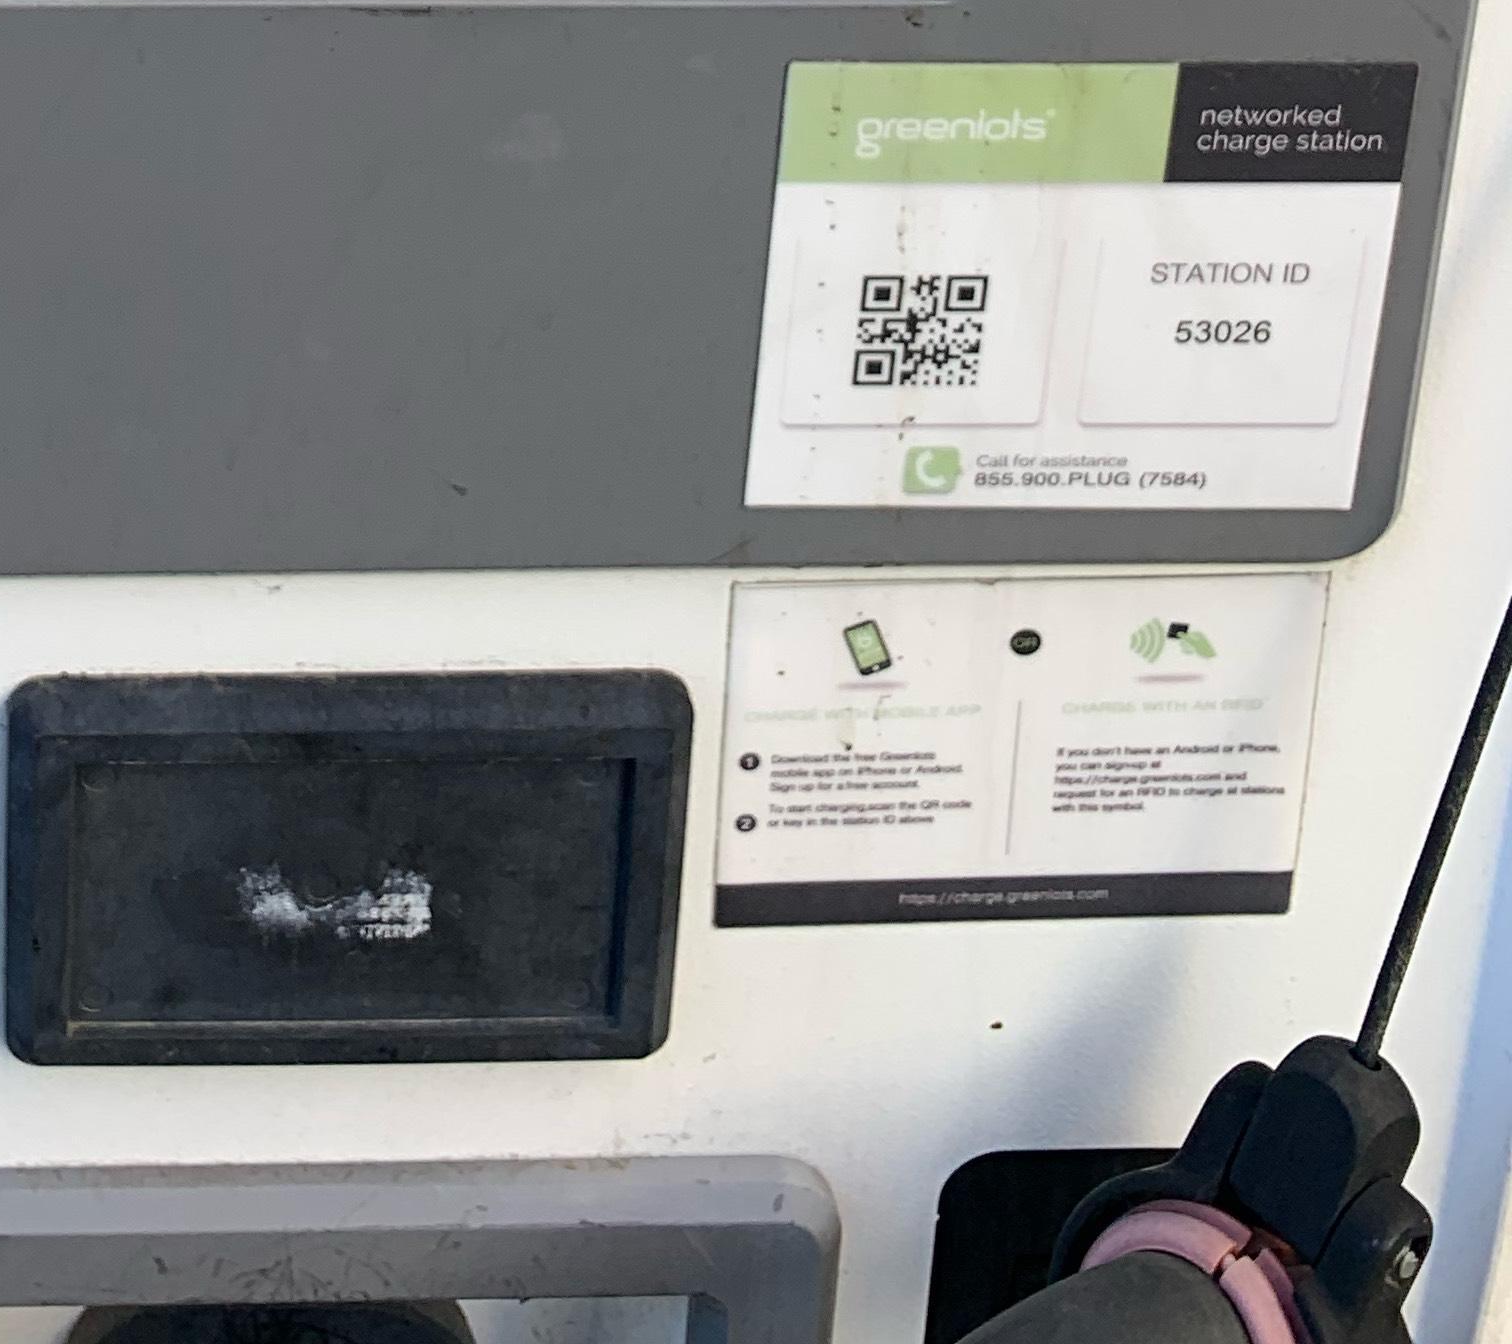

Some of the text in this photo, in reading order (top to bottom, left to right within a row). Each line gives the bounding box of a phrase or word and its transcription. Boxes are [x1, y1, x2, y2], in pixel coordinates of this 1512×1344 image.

[1200, 104, 1343, 127] networked
[855, 108, 1048, 159] greenlots
[1196, 128, 1384, 157] charge station
[1150, 261, 1311, 284] STATION ID
[1174, 319, 1273, 345] 53026
[975, 454, 1129, 468] Call for assistance
[973, 470, 1208, 490] 855.900.PLUG (7584)
